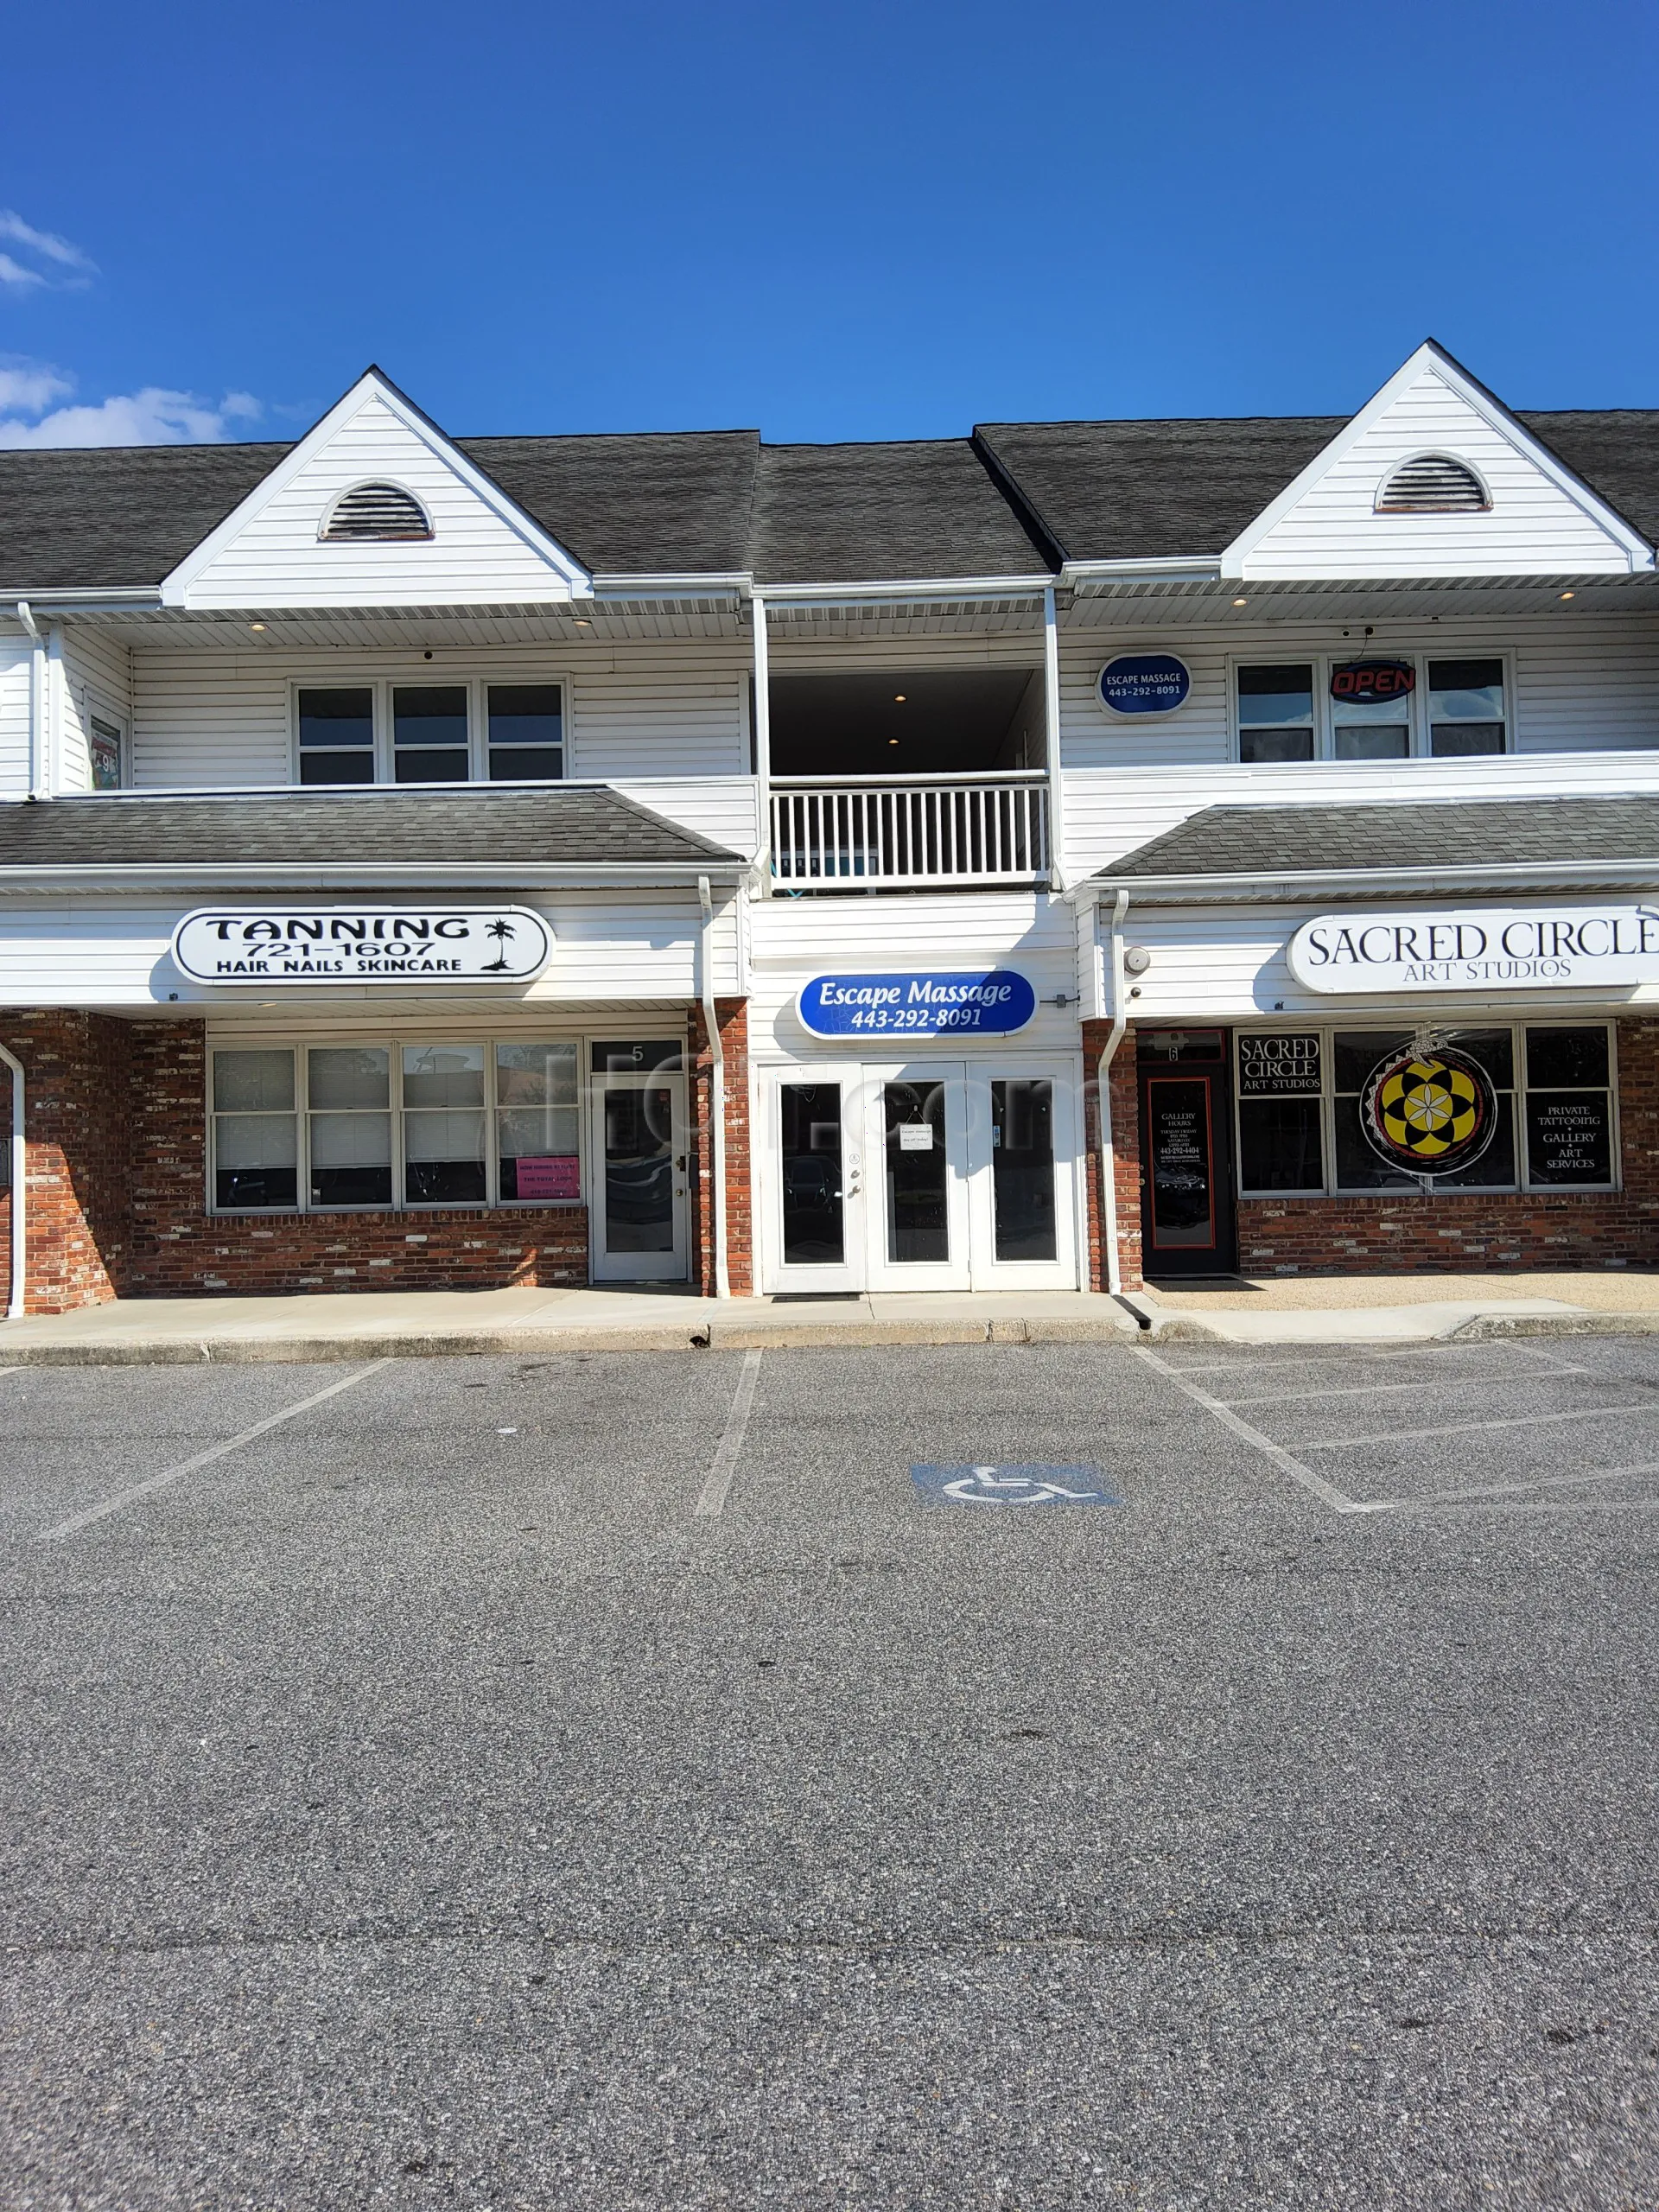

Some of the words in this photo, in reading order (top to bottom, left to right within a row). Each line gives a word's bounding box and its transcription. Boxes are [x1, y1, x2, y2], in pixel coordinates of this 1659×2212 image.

[1106, 675, 1139, 685] ESCAPE
[1141, 673, 1181, 683] MASSAGE
[1332, 670, 1414, 693] OPEN
[1109, 685, 1180, 696] 443-292-8091
[206, 918, 469, 940] TANNING
[1308, 924, 1487, 966] SACRED
[1501, 918, 1659, 959] CIRCLE
[242, 943, 435, 957] 721-1607
[217, 960, 270, 973] HAIR
[283, 959, 343, 973] NAILS
[357, 959, 461, 972] SKINCARE
[1402, 963, 1457, 982] ART
[1465, 958, 1571, 981] STUDIOS
[819, 982, 900, 1007] Escape
[907, 981, 1012, 1007] Massage
[851, 1008, 981, 1027] 443-292-8091
[631, 1046, 644, 1062] 5
[1170, 1048, 1177, 1060] 6
[1241, 1039, 1319, 1061] SACRED
[1245, 1060, 1316, 1077] CIRCLE
[1244, 1080, 1268, 1090] ART
[1272, 1079, 1320, 1089] STUDIOS
[1548, 1106, 1591, 1116] PRIVATE
[1537, 1116, 1600, 1126] TATTOOING
[1542, 1133, 1597, 1143] GALLERY
[1559, 1149, 1583, 1158] ART
[1547, 1159, 1595, 1168] SERVICES
